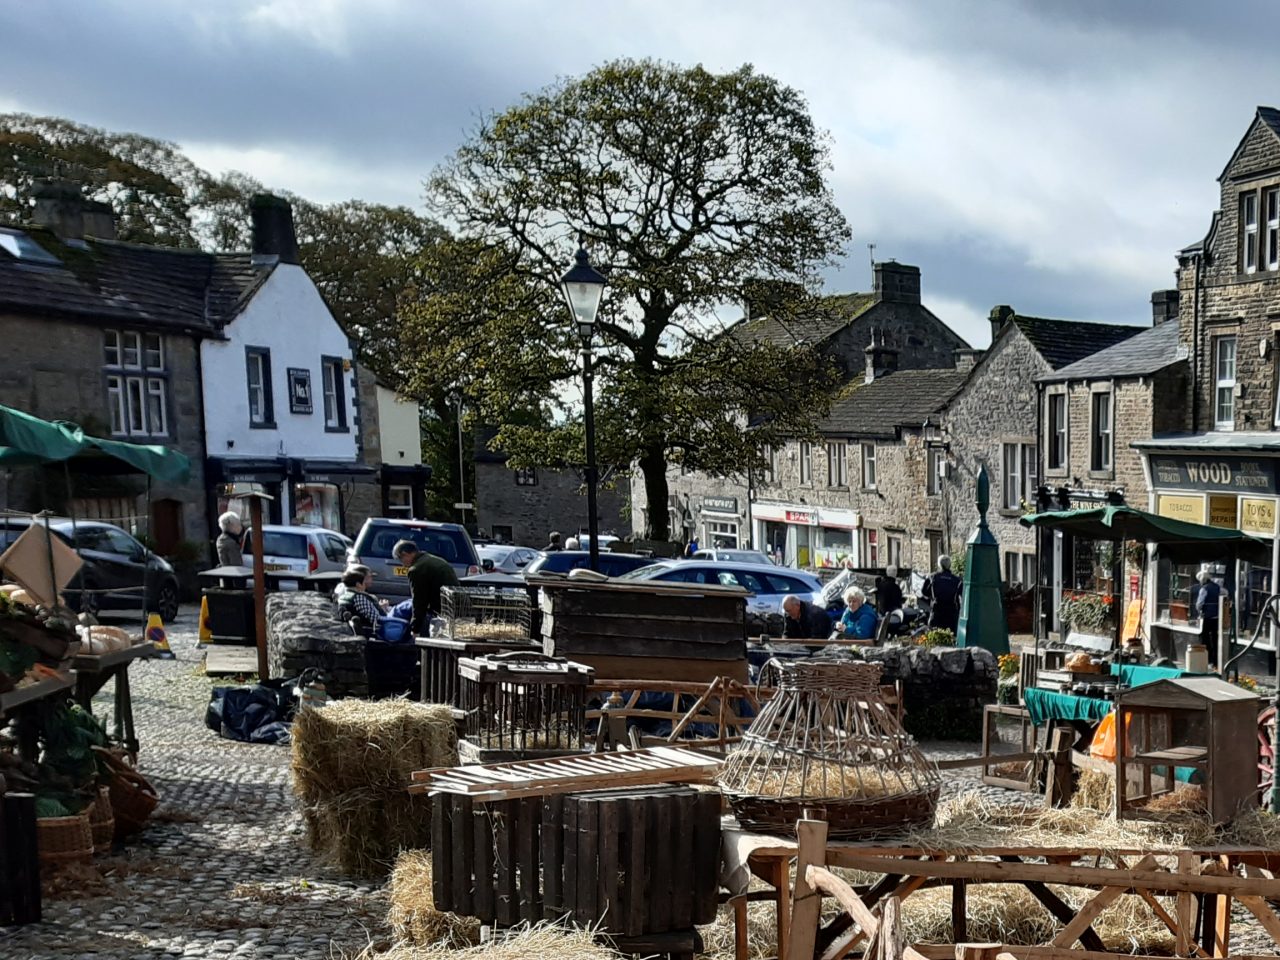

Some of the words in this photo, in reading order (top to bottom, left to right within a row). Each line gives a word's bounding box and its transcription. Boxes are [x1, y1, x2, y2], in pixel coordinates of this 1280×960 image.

[1185, 461, 1232, 484] WOOD
[1235, 475, 1268, 487] STATIONERY
[1168, 502, 1193, 512] TOBACCO
[1246, 503, 1266, 517] TOYS
[1266, 509, 1272, 517] &
[791, 512, 809, 521] SPAR
